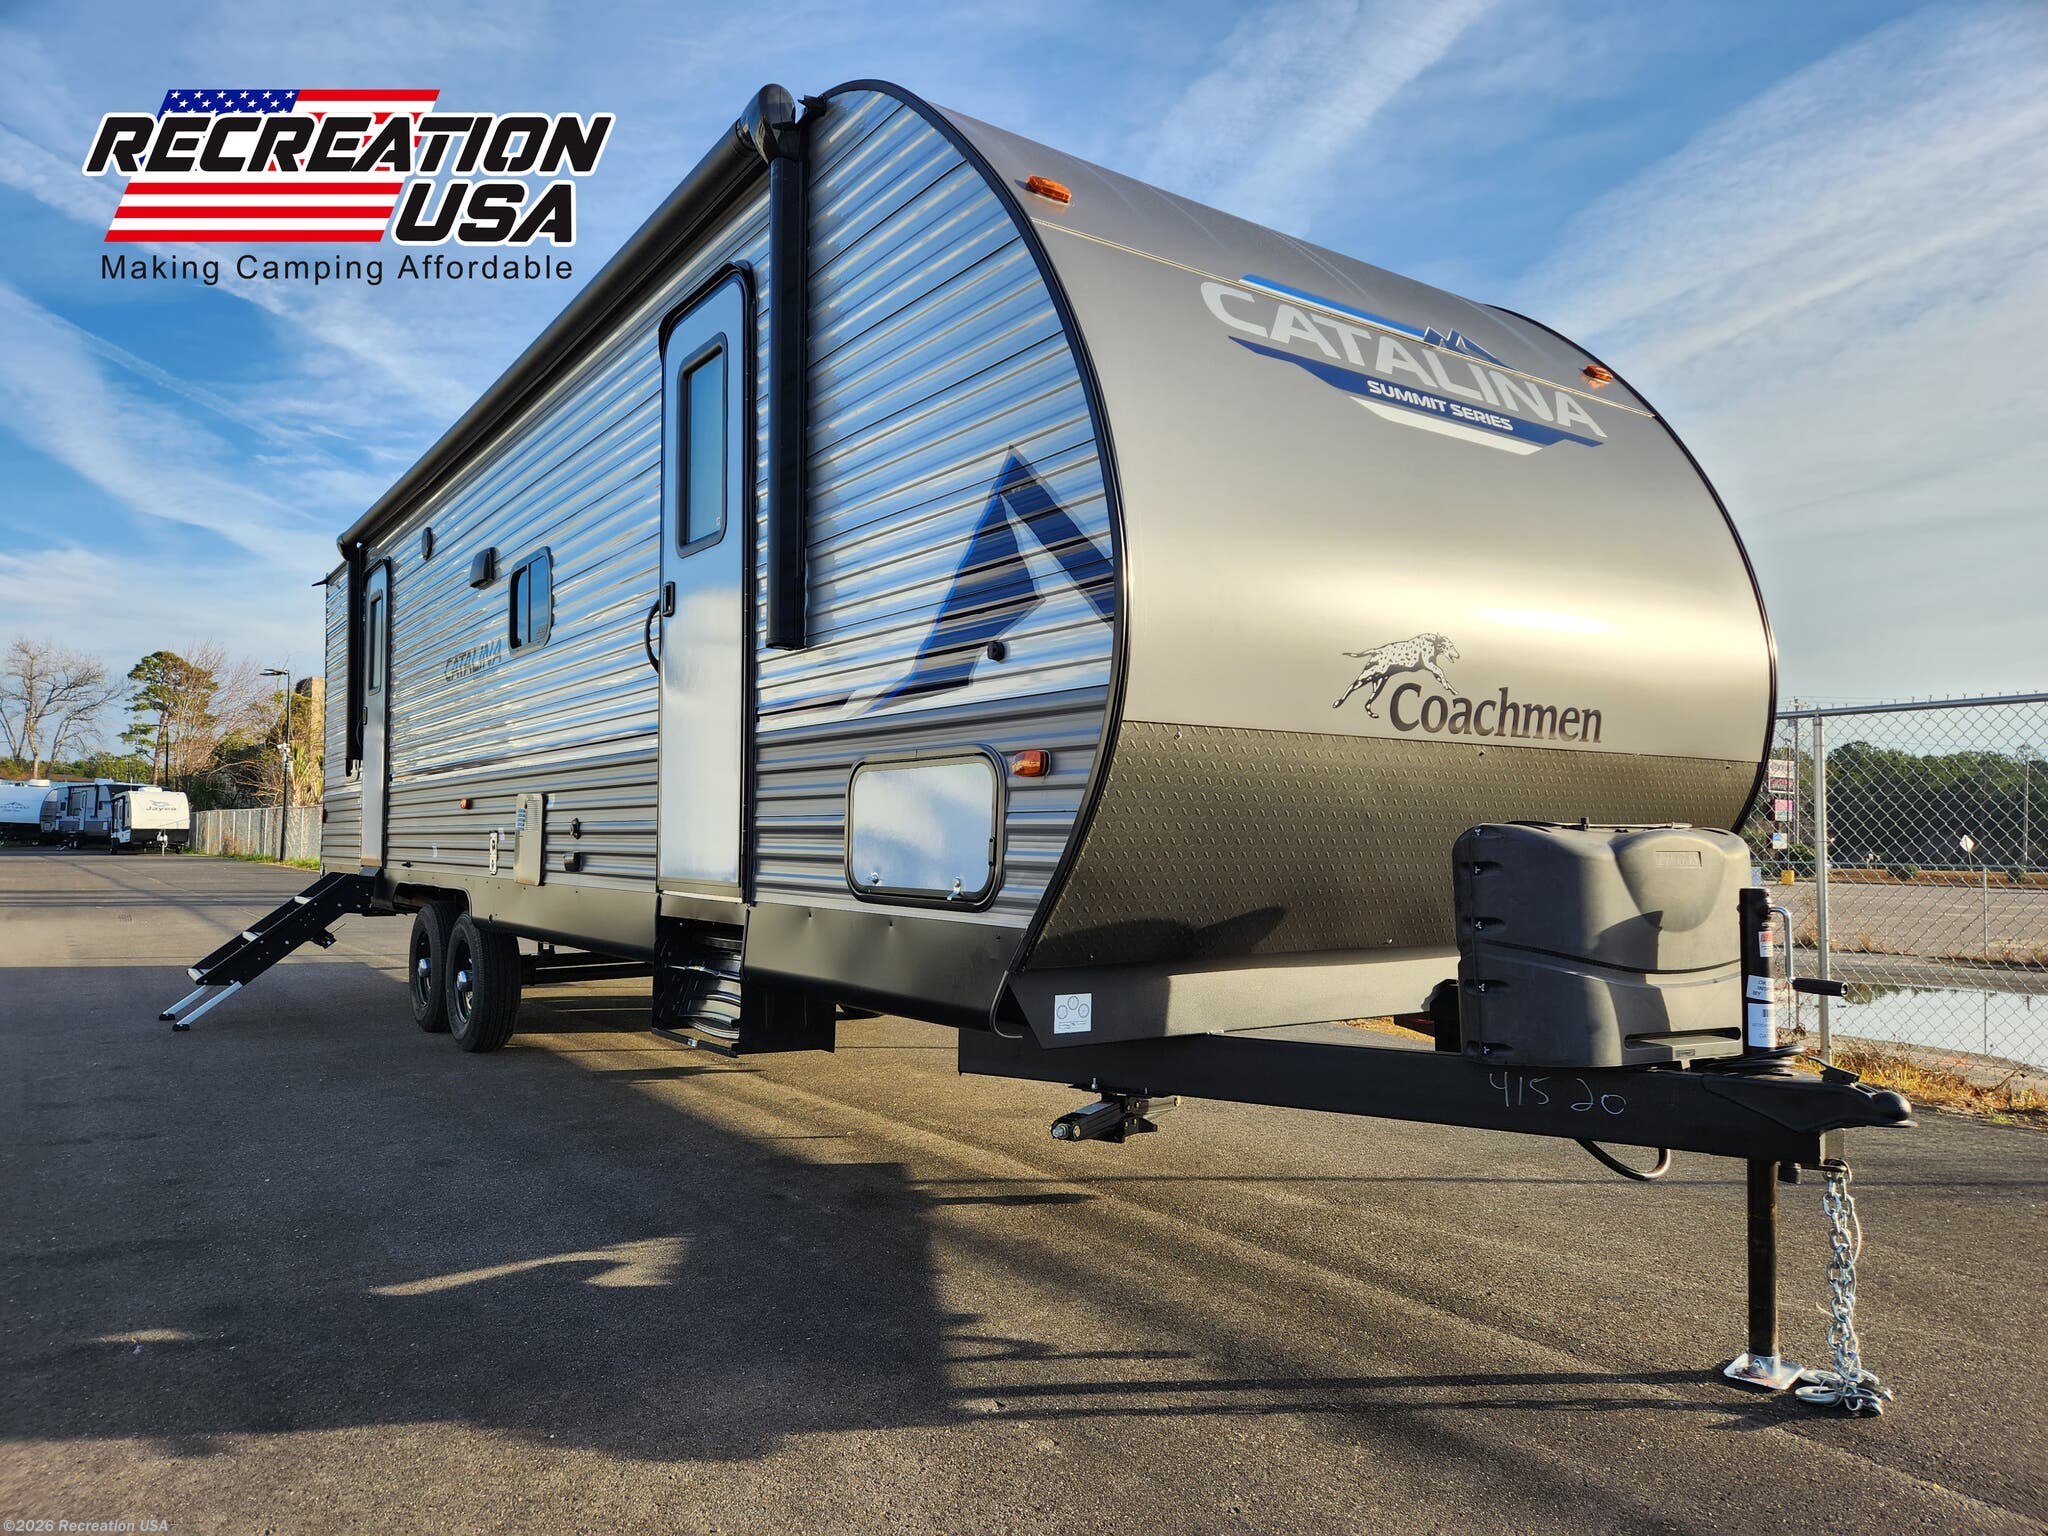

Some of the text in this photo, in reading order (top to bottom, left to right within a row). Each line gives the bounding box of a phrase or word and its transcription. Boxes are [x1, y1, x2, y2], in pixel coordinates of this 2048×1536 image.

[1200, 281, 1608, 438] CATALINA
[1366, 379, 1514, 431] SUMMIT SERIES
[1389, 682, 1602, 743] Coachmen
